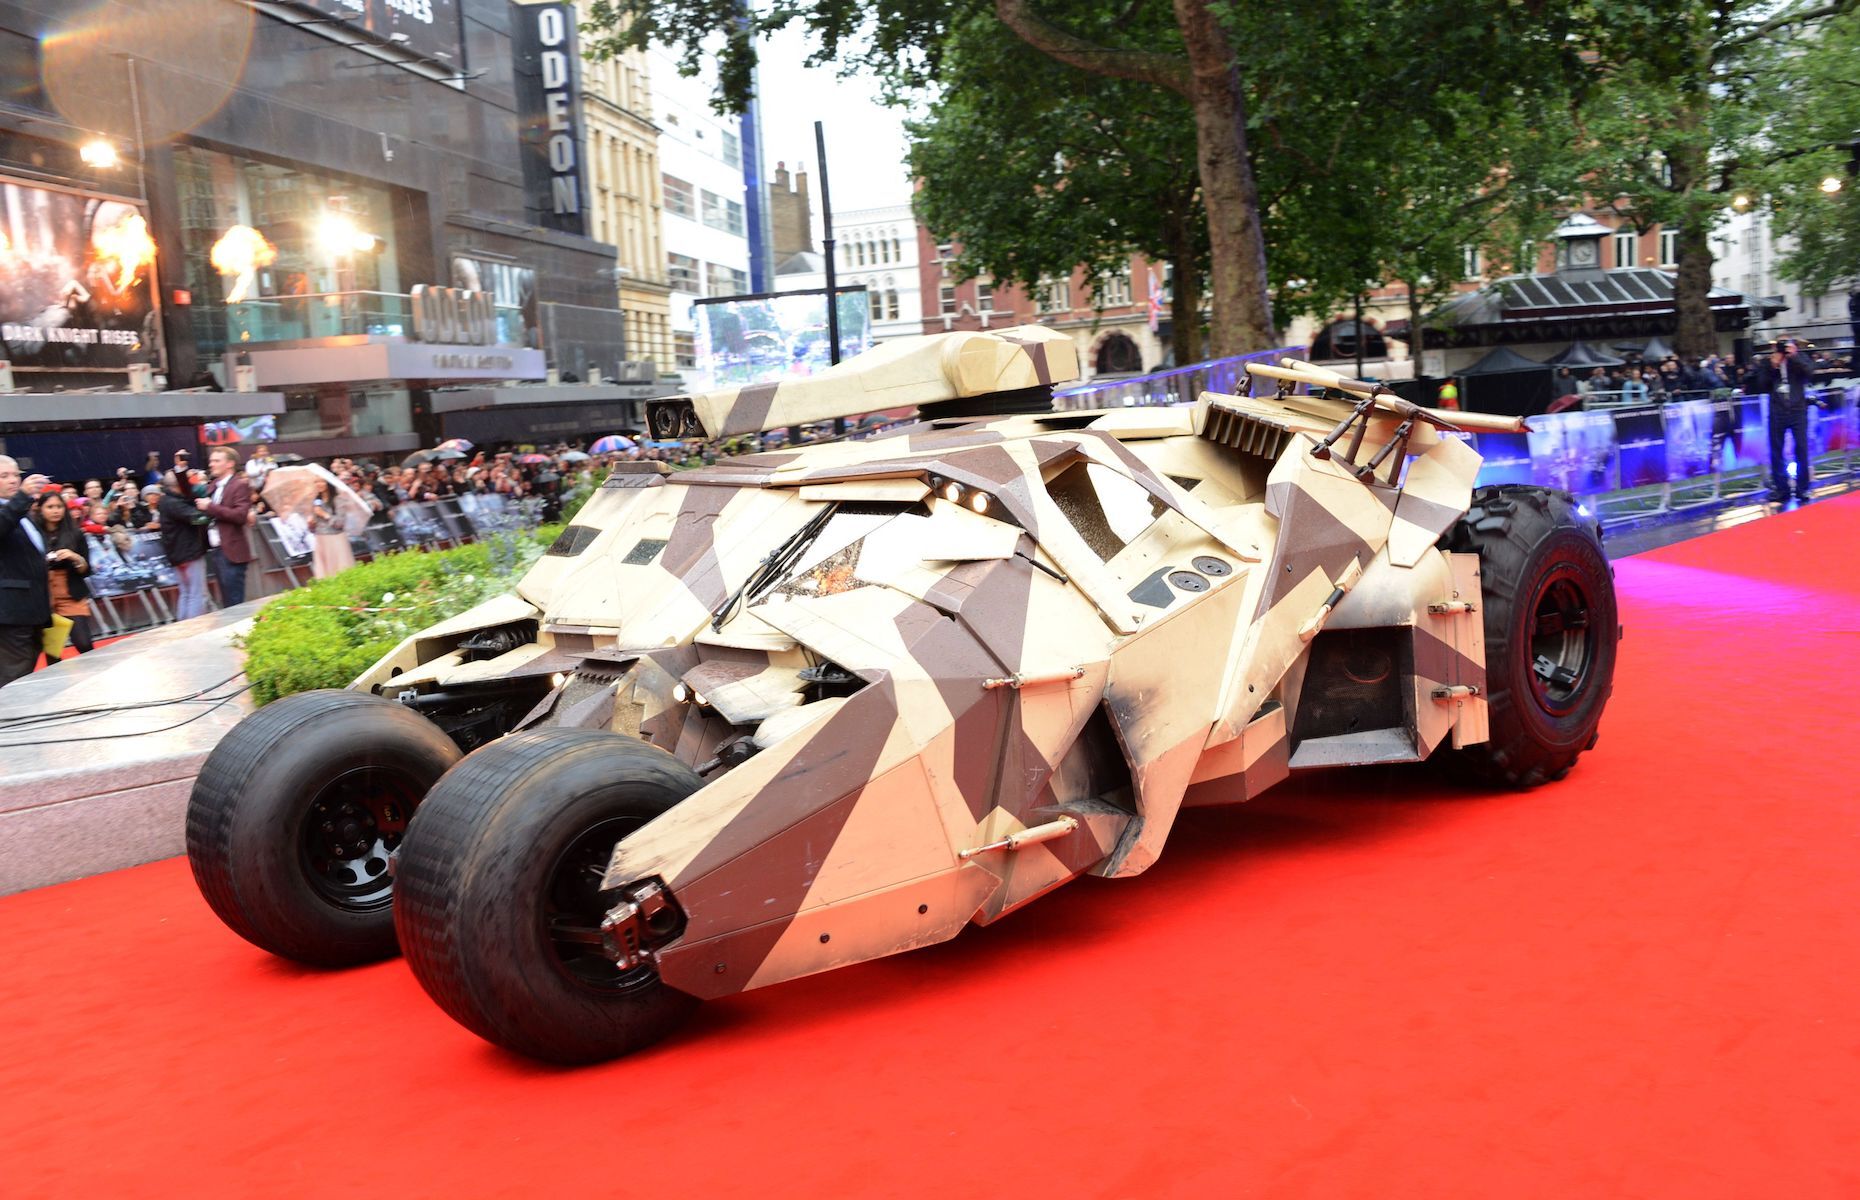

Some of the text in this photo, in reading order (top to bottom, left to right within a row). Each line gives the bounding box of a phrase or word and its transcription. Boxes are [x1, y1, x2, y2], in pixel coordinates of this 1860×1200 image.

[538, 8, 579, 214] ODEON
[2, 325, 139, 345] DARK KNIGHT RISES
